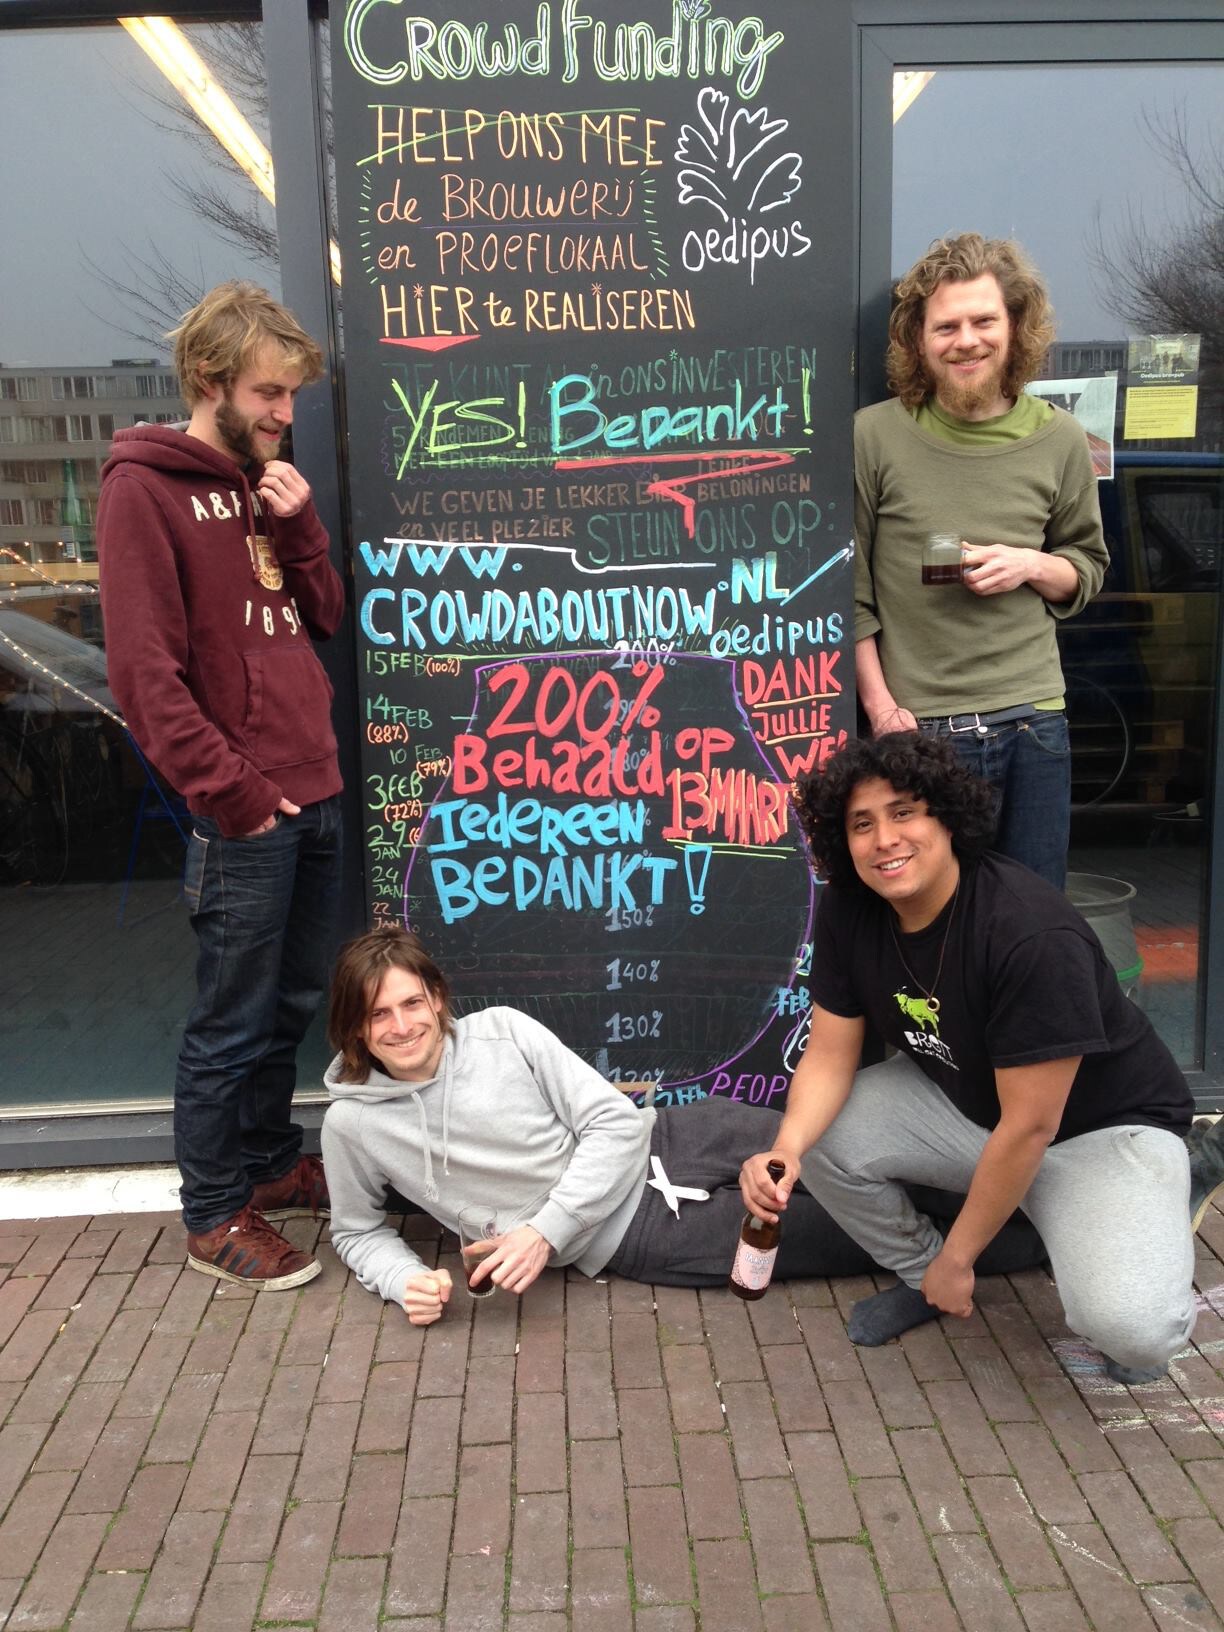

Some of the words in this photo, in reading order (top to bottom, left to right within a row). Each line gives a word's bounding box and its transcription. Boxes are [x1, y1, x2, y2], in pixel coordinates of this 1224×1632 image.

[377, 105, 487, 164] HELP
[497, 110, 565, 160] ONS
[581, 114, 666, 166] MEE
[377, 189, 422, 223] de
[377, 242, 416, 270] en
[682, 218, 812, 285] oedipus
[483, 297, 517, 328] te
[620, 358, 666, 396] ONS
[391, 378, 528, 481] YES!
[391, 491, 434, 516] WE
[441, 488, 514, 515] GEVEN
[520, 487, 546, 511] JE
[555, 483, 630, 511] LEKKER
[396, 520, 426, 538] en
[430, 519, 484, 542] VEEL
[587, 508, 680, 565] STEUN
[694, 503, 756, 554] ONS
[709, 613, 843, 660] oedipus
[366, 650, 388, 676] 15
[390, 652, 426, 678] FEB
[425, 657, 461, 678] (100%)
[607, 638, 677, 671] 200%
[743, 651, 842, 705] DANK
[366, 693, 391, 720] 14
[390, 705, 433, 729] FEB
[486, 659, 665, 744] 200%
[366, 722, 409, 744] (88%)
[390, 748, 407, 766] 10
[452, 730, 665, 796] Behaald
[366, 774, 388, 810] 3
[388, 770, 423, 801] FEB
[661, 768, 714, 841] 13
[708, 768, 791, 846] MAART
[366, 820, 407, 848] 29
[371, 847, 401, 860] JAN
[371, 865, 399, 883] 24
[371, 884, 404, 899] JAN
[371, 901, 392, 916] 22
[604, 904, 657, 932] 150%
[606, 957, 661, 991] 140%
[771, 986, 811, 1016] FEB
[605, 1010, 664, 1042] 130%
[709, 1071, 788, 1106] PEOP
